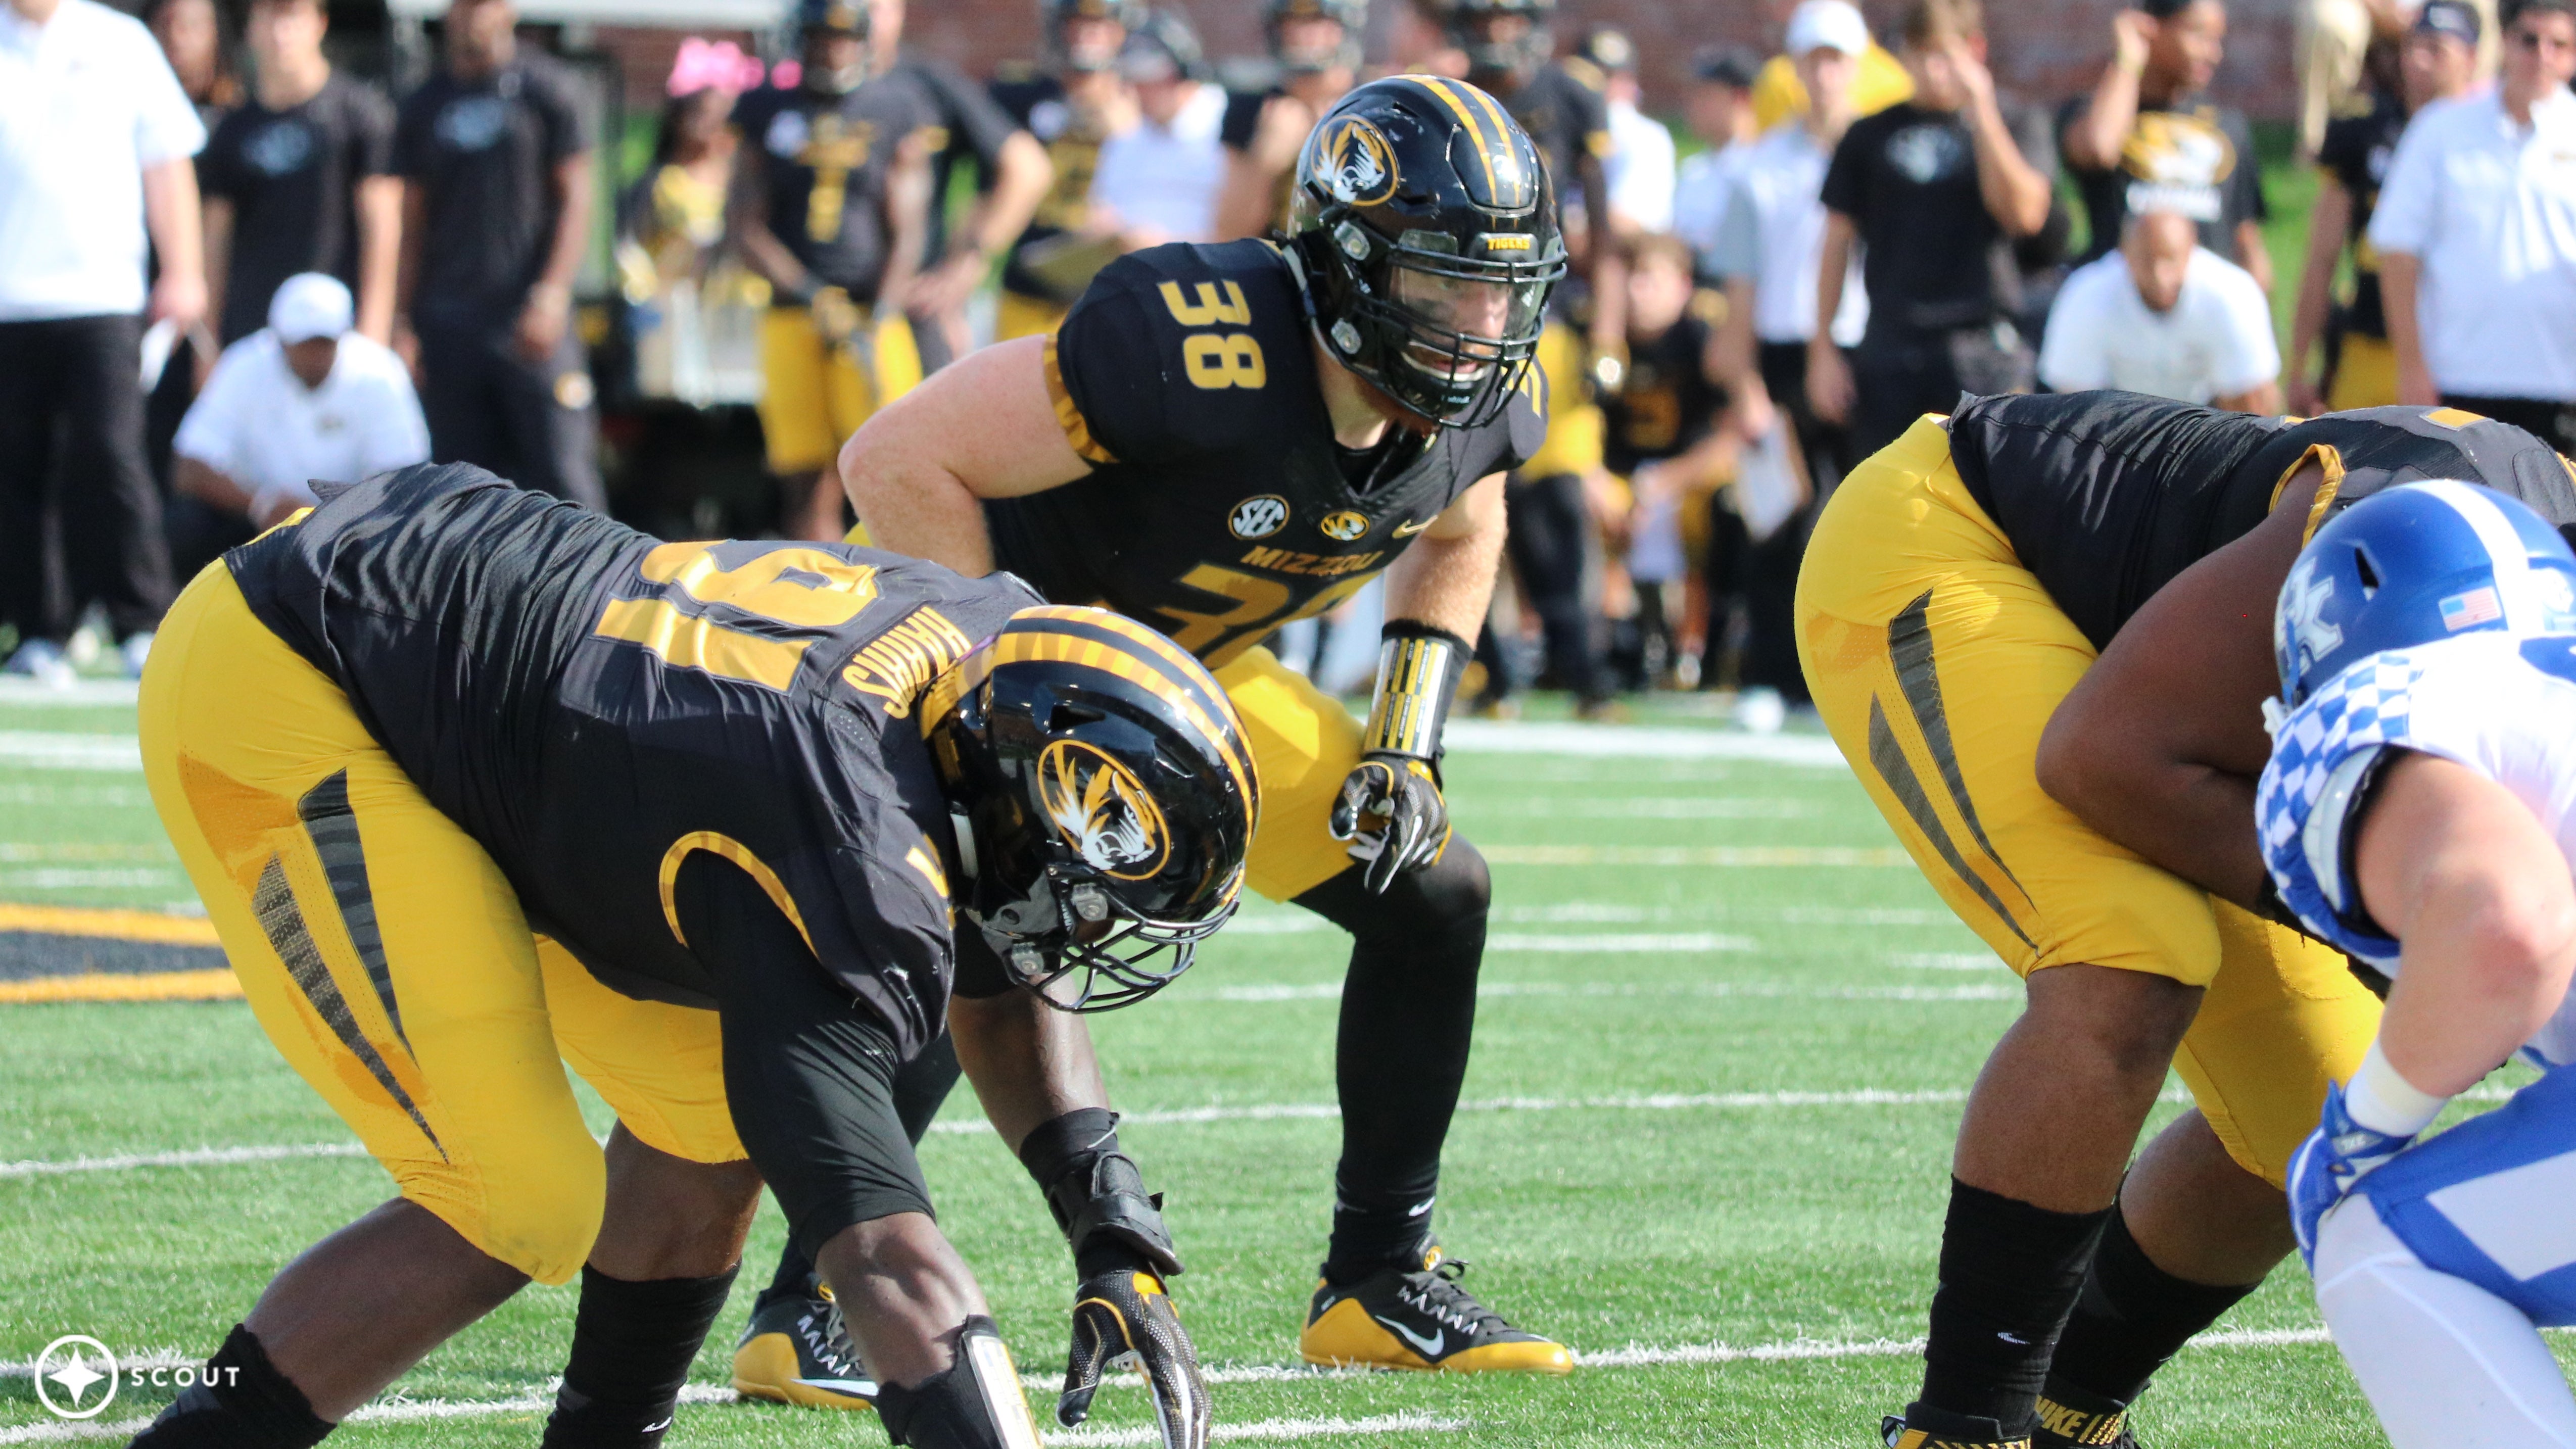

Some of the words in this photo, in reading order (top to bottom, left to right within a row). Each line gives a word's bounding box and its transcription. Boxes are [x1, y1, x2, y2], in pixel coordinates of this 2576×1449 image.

[1487, 237, 1531, 251] TIGERS
[1157, 279, 1267, 390] 38
[1232, 499, 1285, 538] SEC
[1240, 545, 1384, 576] MIZZOU
[842, 606, 973, 719] HARRIS
[2034, 1393, 2089, 1438] NIKE
